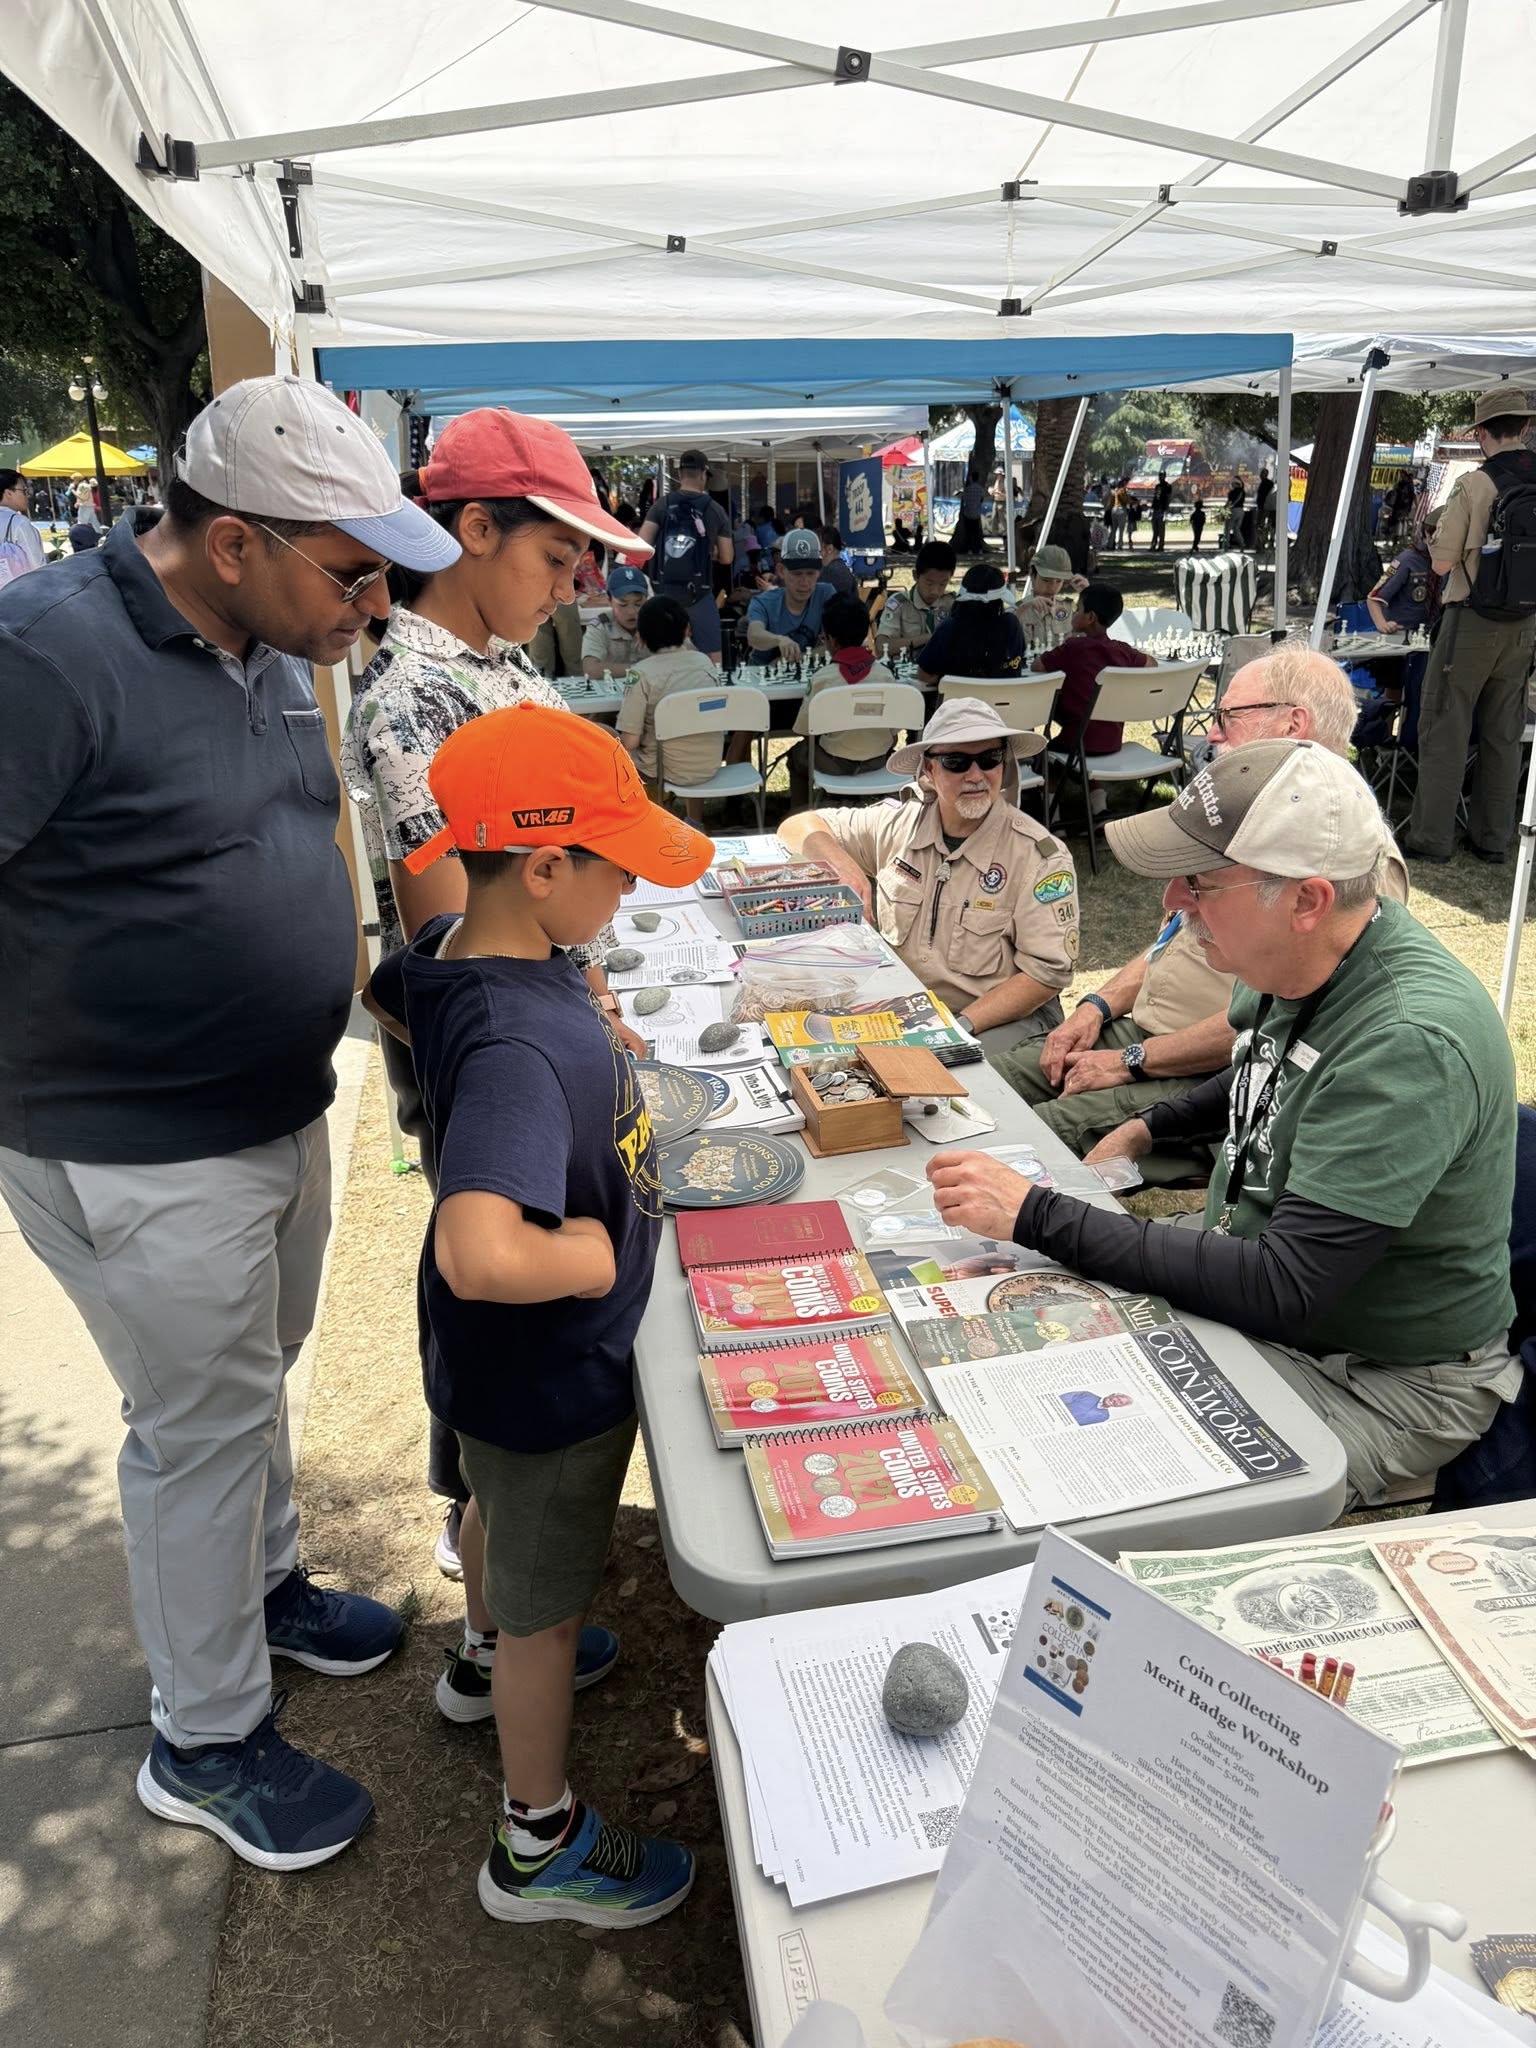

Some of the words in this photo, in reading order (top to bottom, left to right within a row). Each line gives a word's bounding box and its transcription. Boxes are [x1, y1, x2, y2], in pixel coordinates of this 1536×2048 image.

[659, 1066, 695, 1085] COINS
[690, 1084, 702, 1104] FOR
[744, 1074, 758, 1089] Who
[683, 1102, 702, 1120] YOU
[738, 1140, 773, 1160] COINS
[768, 1160, 779, 1178] FOR
[753, 1176, 776, 1191] YOU
[779, 1264, 832, 1318] COINS
[811, 1263, 832, 1288] UNITED
[821, 1289, 843, 1314] STATES
[771, 1358, 829, 1410] 2011
[813, 1358, 854, 1402] COINS
[830, 1343, 862, 1377] UNITED
[846, 1378, 878, 1410] STATES
[1140, 1329, 1210, 1390] COIN
[967, 1377, 979, 1388] THE
[974, 1389, 988, 1405] NEWS
[1117, 1341, 1152, 1373] Hansen
[1142, 1373, 1184, 1413] Collection
[1174, 1413, 1209, 1445] moving
[1200, 1443, 1216, 1453] to
[1208, 1452, 1236, 1474] CACG
[835, 1447, 902, 1511] 2021
[877, 1446, 926, 1499] COINS
[895, 1429, 932, 1468] UNITED
[915, 1469, 953, 1510] STATES
[765, 1483, 782, 1514] EDITION
[1496, 1598, 1520, 1608] PAN
[1041, 1621, 1093, 1663] COLLECTING
[1058, 1622, 1081, 1644] COIN
[1316, 1626, 1384, 1648] Tobacco
[1177, 1652, 1216, 1688] Coin
[1216, 1677, 1303, 1747] Collecting
[1142, 1658, 1187, 1699] Merit
[1187, 1688, 1238, 1735] Badge
[1237, 1722, 1331, 1799] Workshop
[1206, 1729, 1244, 1763] Saturday
[1179, 1736, 1201, 1759] 11:00
[1201, 1752, 1215, 1769] am
[1222, 1767, 1244, 1789] 5:00
[1243, 1782, 1260, 1800] pm
[1189, 1730, 1223, 1760] October
[1231, 1760, 1255, 1783] 2025
[992, 1786, 1042, 1832] Prerequisites:
[1109, 1749, 1129, 1771] 1900
[1128, 1763, 1145, 1782] The
[1144, 1774, 1182, 1809] Alameda,
[1181, 1801, 1204, 1825] Suite
[1221, 1830, 1240, 1851] San
[1262, 1860, 1278, 1879] CA
[1136, 1756, 1164, 1783] Silicon
[1163, 1775, 1189, 1801] Valley
[1188, 1793, 1228, 1829] Monterey
[1228, 1822, 1246, 1842] Bay
[1245, 1834, 1280, 1866] Council
[1153, 1756, 1173, 1777] Coin
[1172, 1769, 1213, 1805] Collecting
[1213, 1798, 1237, 1823] Merit
[1237, 1816, 1265, 1843] Badge
[1169, 1754, 1192, 1777] Have
[1191, 1769, 1206, 1787] fun
[1205, 1780, 1239, 1811] earning
[1238, 1803, 1254, 1822] the
[1034, 1775, 1074, 1813] Registration
[1170, 1881, 1191, 1904] open
[1001, 1825, 1017, 1843] Read
[1016, 1837, 1028, 1852] the
[1026, 1845, 1042, 1864] Coin
[1041, 1857, 1072, 1889] Collecting
[1071, 1882, 1090, 1904] Merit
[1089, 1897, 1110, 1921] Badge
[1064, 1862, 1081, 1882] Card
[1080, 1876, 1102, 1900] signed
[1101, 1893, 1110, 1906] by
[1109, 1900, 1126, 1919] your
[1082, 1848, 1121, 1886] Questions?
[1068, 1893, 1080, 1909] QR
[1079, 1902, 1095, 1921] code
[1095, 1915, 1106, 1930] for
[1105, 1924, 1130, 1950] current
